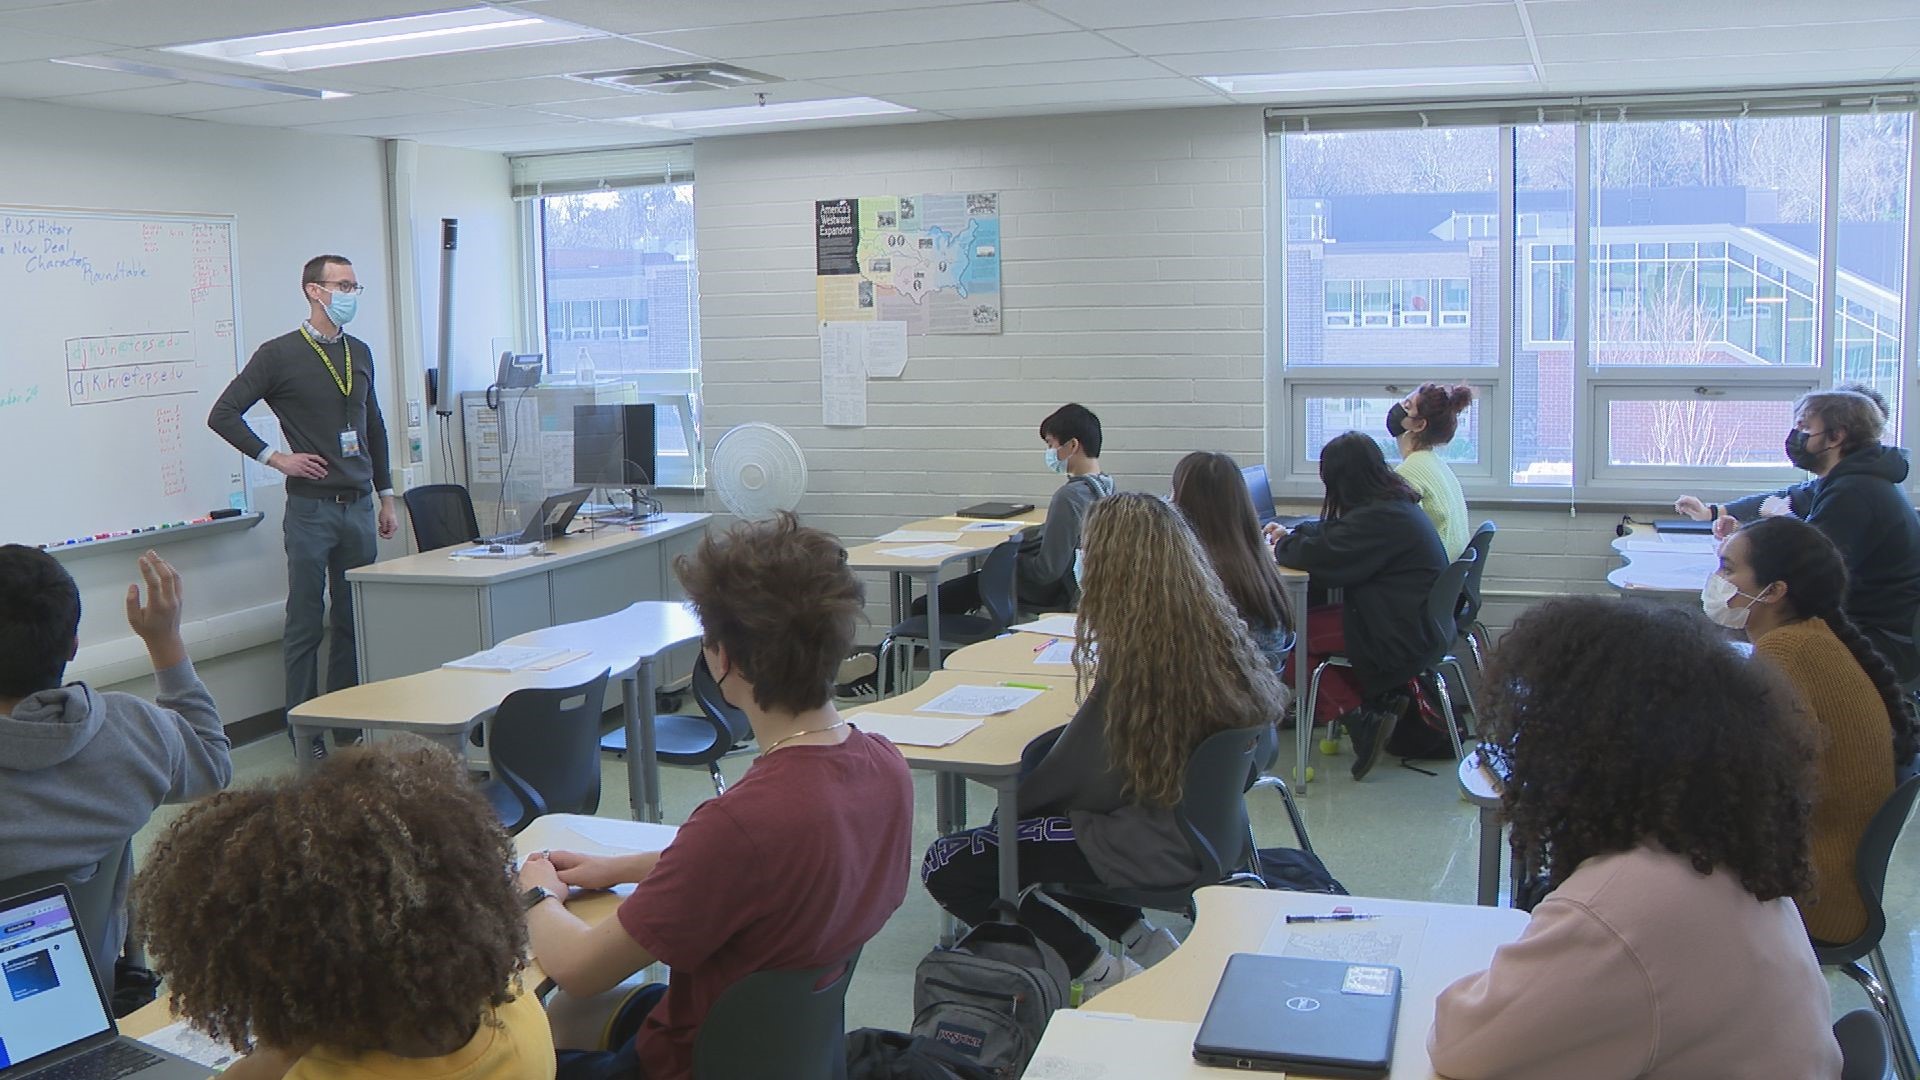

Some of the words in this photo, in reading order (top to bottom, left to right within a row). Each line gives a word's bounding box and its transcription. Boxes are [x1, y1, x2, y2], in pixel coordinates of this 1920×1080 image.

[820, 204, 851, 215] America's
[821, 215, 851, 225] Westward
[820, 225, 853, 237] Expansion
[13, 240, 37, 255] New
[43, 238, 70, 253] Deal
